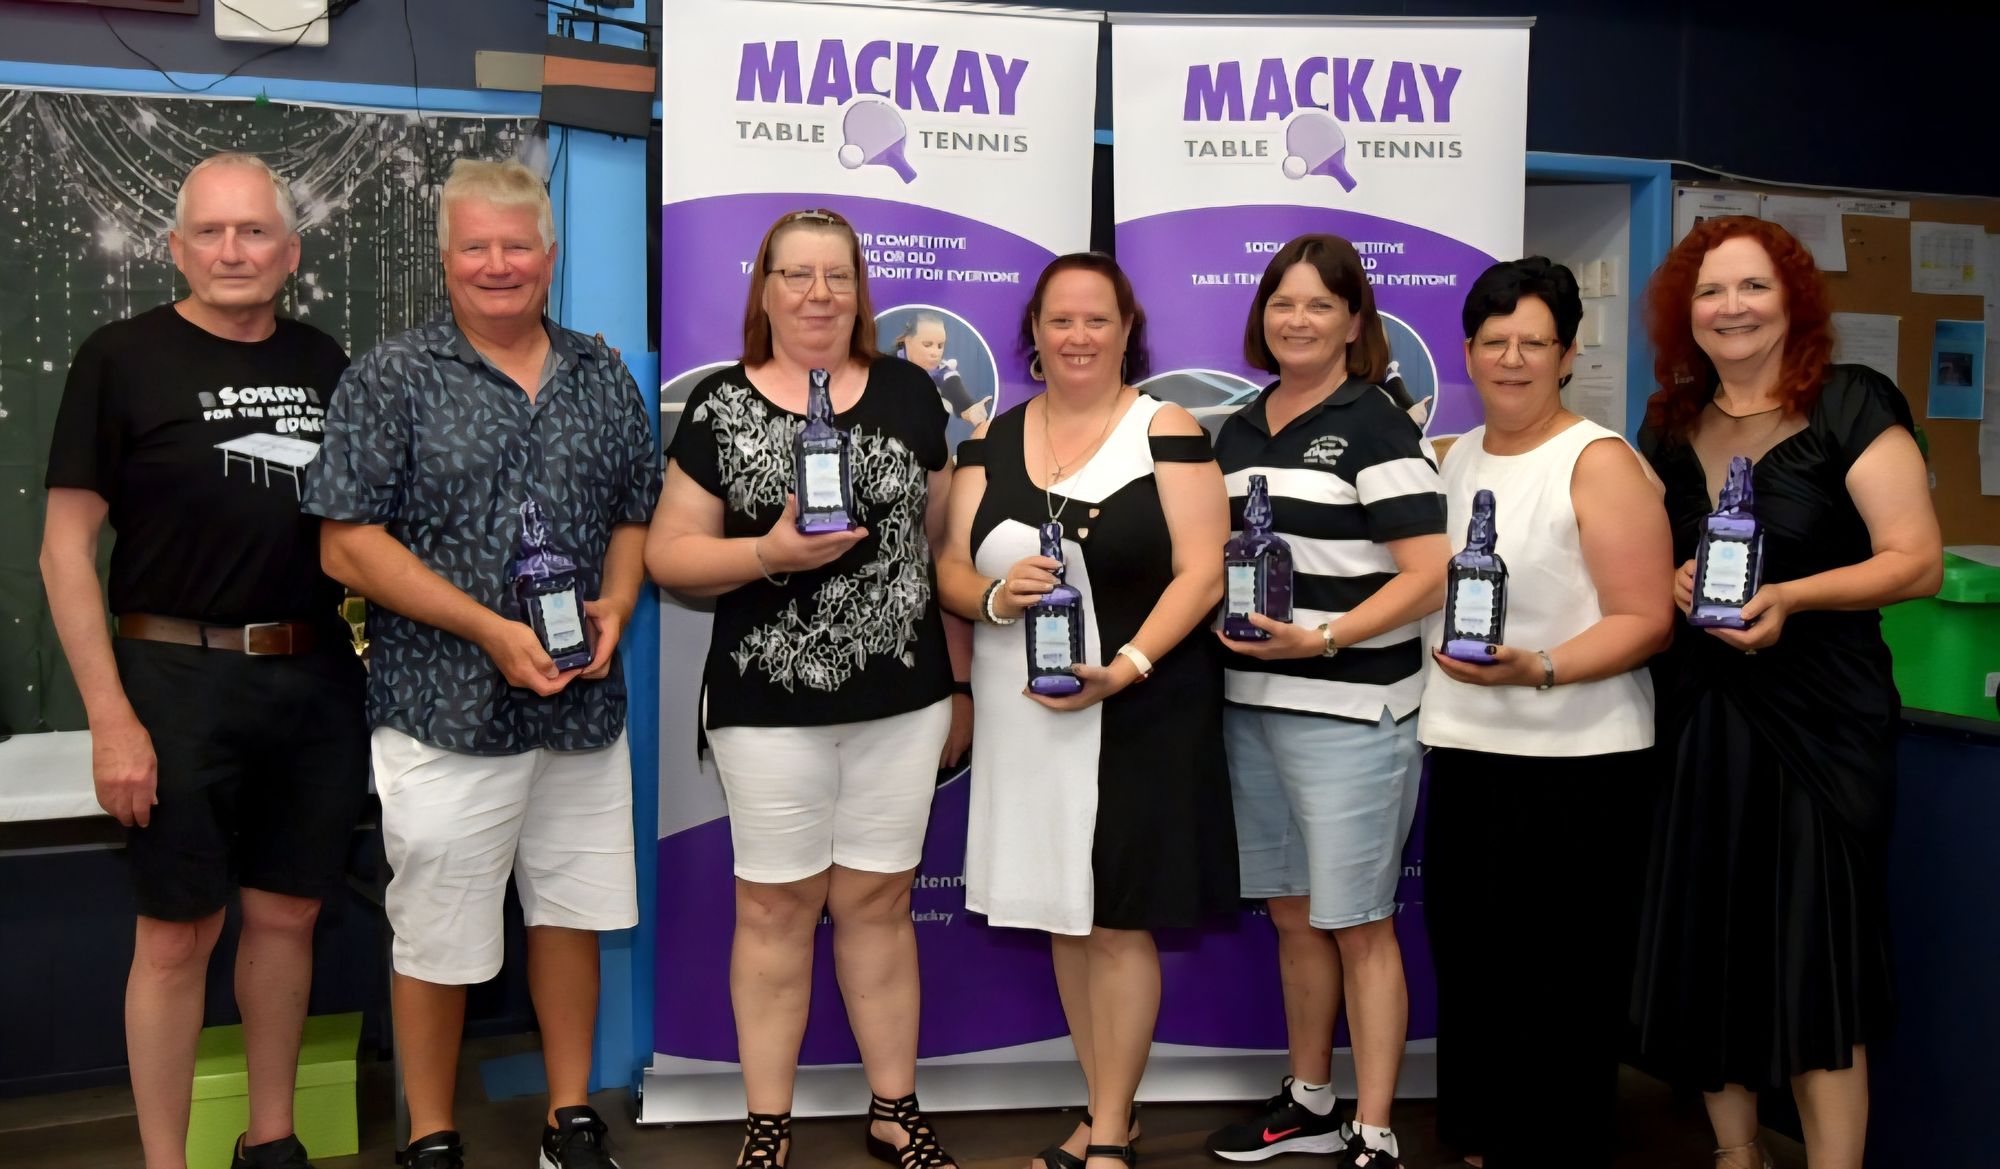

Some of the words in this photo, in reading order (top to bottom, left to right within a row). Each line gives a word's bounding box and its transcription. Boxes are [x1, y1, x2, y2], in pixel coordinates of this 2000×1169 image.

[736, 39, 1029, 116] MACKAY
[1183, 56, 1462, 123] MACKAY
[736, 120, 825, 144] TABLE
[919, 130, 1028, 153] TENNIS
[1184, 139, 1268, 158] TABLE
[1357, 140, 1462, 159] TENNIS
[876, 233, 967, 250] COMPETITIVE
[907, 251, 936, 265] OLD
[915, 267, 944, 281] FOR
[946, 269, 1019, 284] EVERYONE
[1191, 273, 1229, 285] TABLE
[1387, 274, 1457, 286] EVERYONE
[218, 386, 307, 405] SORRY
[203, 408, 234, 421] FOR
